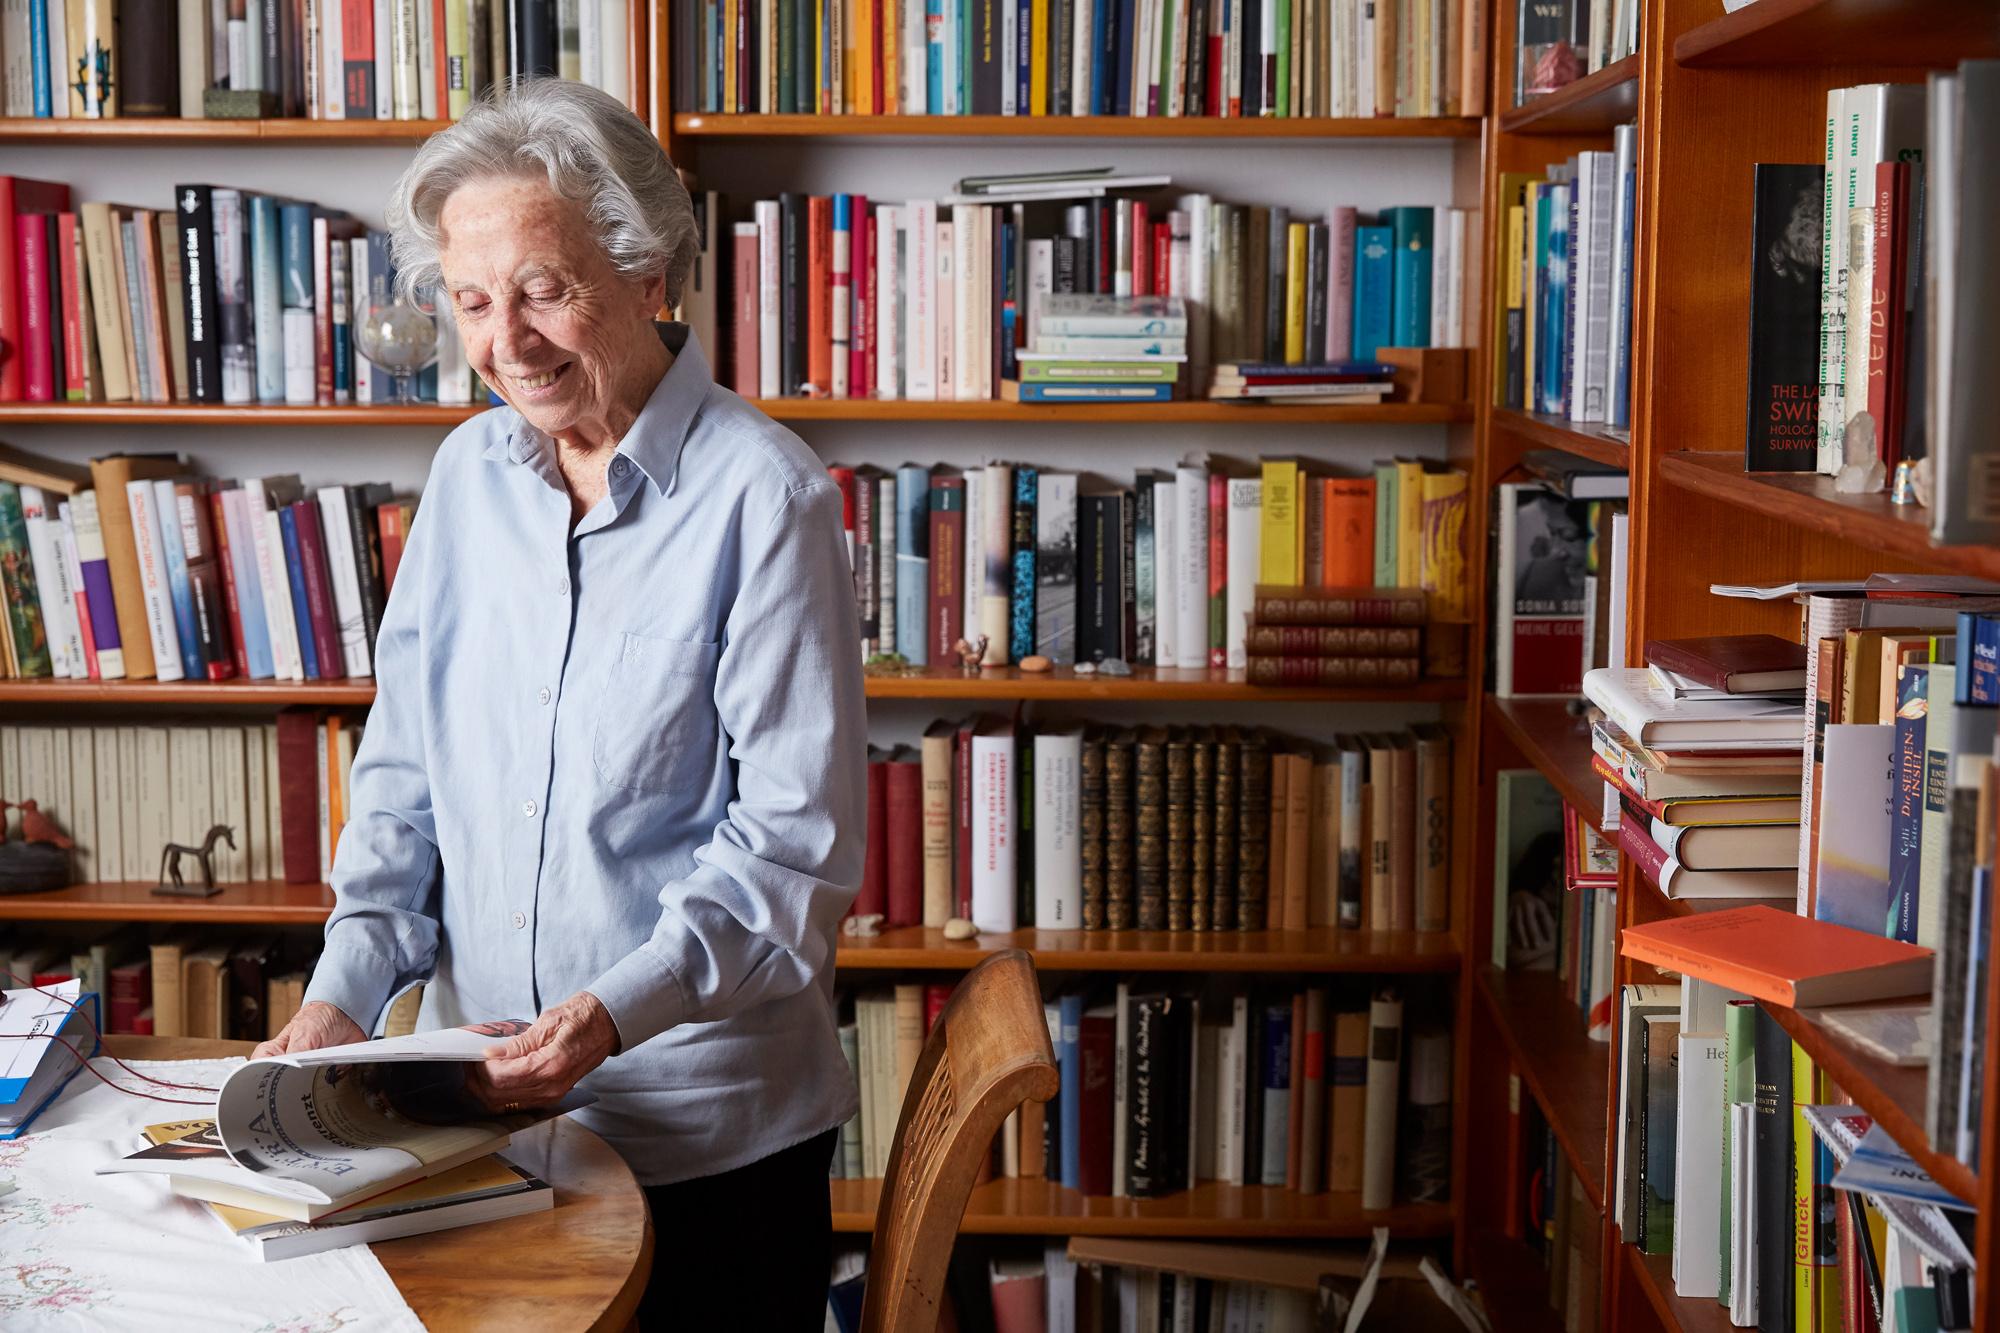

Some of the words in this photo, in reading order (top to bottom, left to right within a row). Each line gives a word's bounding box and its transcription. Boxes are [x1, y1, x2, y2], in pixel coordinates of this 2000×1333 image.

[1826, 129, 1836, 161] BAND
[1849, 125, 1860, 157] BAND
[1825, 170, 1835, 241] GESCHICHTE
[1880, 191, 1889, 237] BARICCO
[1823, 244, 1832, 285] GALLER
[1869, 287, 1886, 376] SEIDE
[1771, 385, 1799, 399] THE
[1802, 385, 1818, 399] LA
[1770, 425, 1816, 435] HOLOCA
[1902, 727, 1914, 793] SEIDEN-
[1912, 750, 1923, 797] INSEL
[1901, 796, 1912, 817] Die
[1900, 827, 1911, 857] Kelli
[1902, 892, 1911, 931] GOLDMANN
[1706, 1047, 1725, 1060] He
[162, 1120, 217, 1132] WO
[1797, 1196, 1809, 1260] Glück
